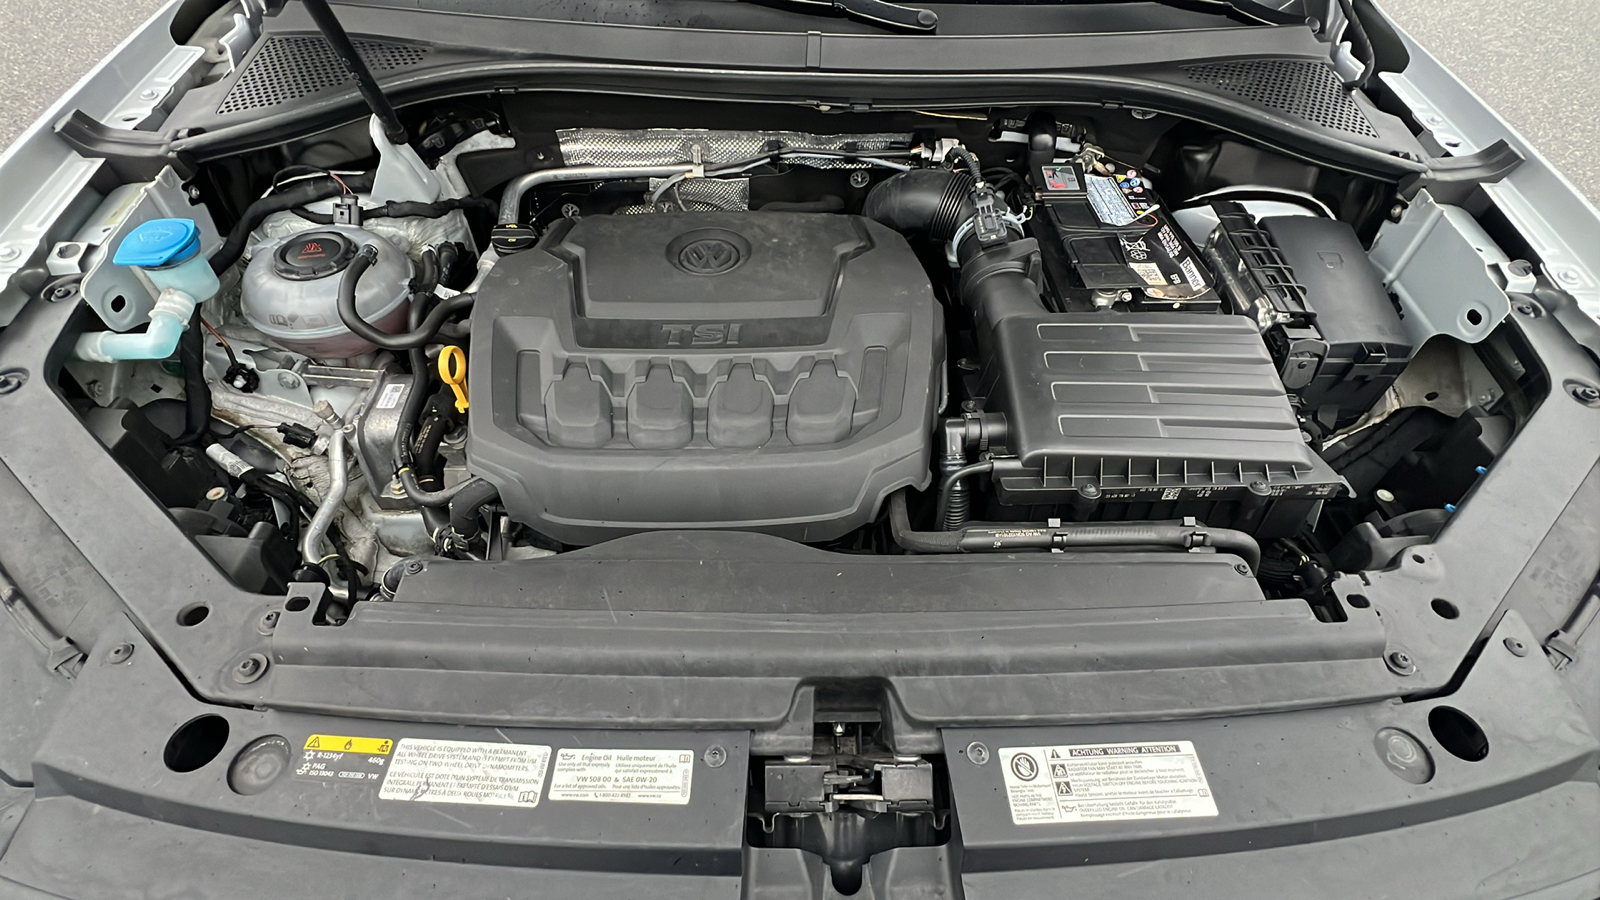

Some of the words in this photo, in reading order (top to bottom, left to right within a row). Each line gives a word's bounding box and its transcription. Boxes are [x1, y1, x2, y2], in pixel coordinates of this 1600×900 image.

[1182, 259, 1202, 288] Banner
[661, 323, 741, 345] TSI
[1072, 748, 1104, 756] ACHTUNG
[1106, 747, 1139, 755] WARNING
[1141, 745, 1177, 753] ATTENTION
[317, 752, 344, 761] R-1234yf
[367, 757, 385, 766] 460g
[582, 754, 602, 762] Engine
